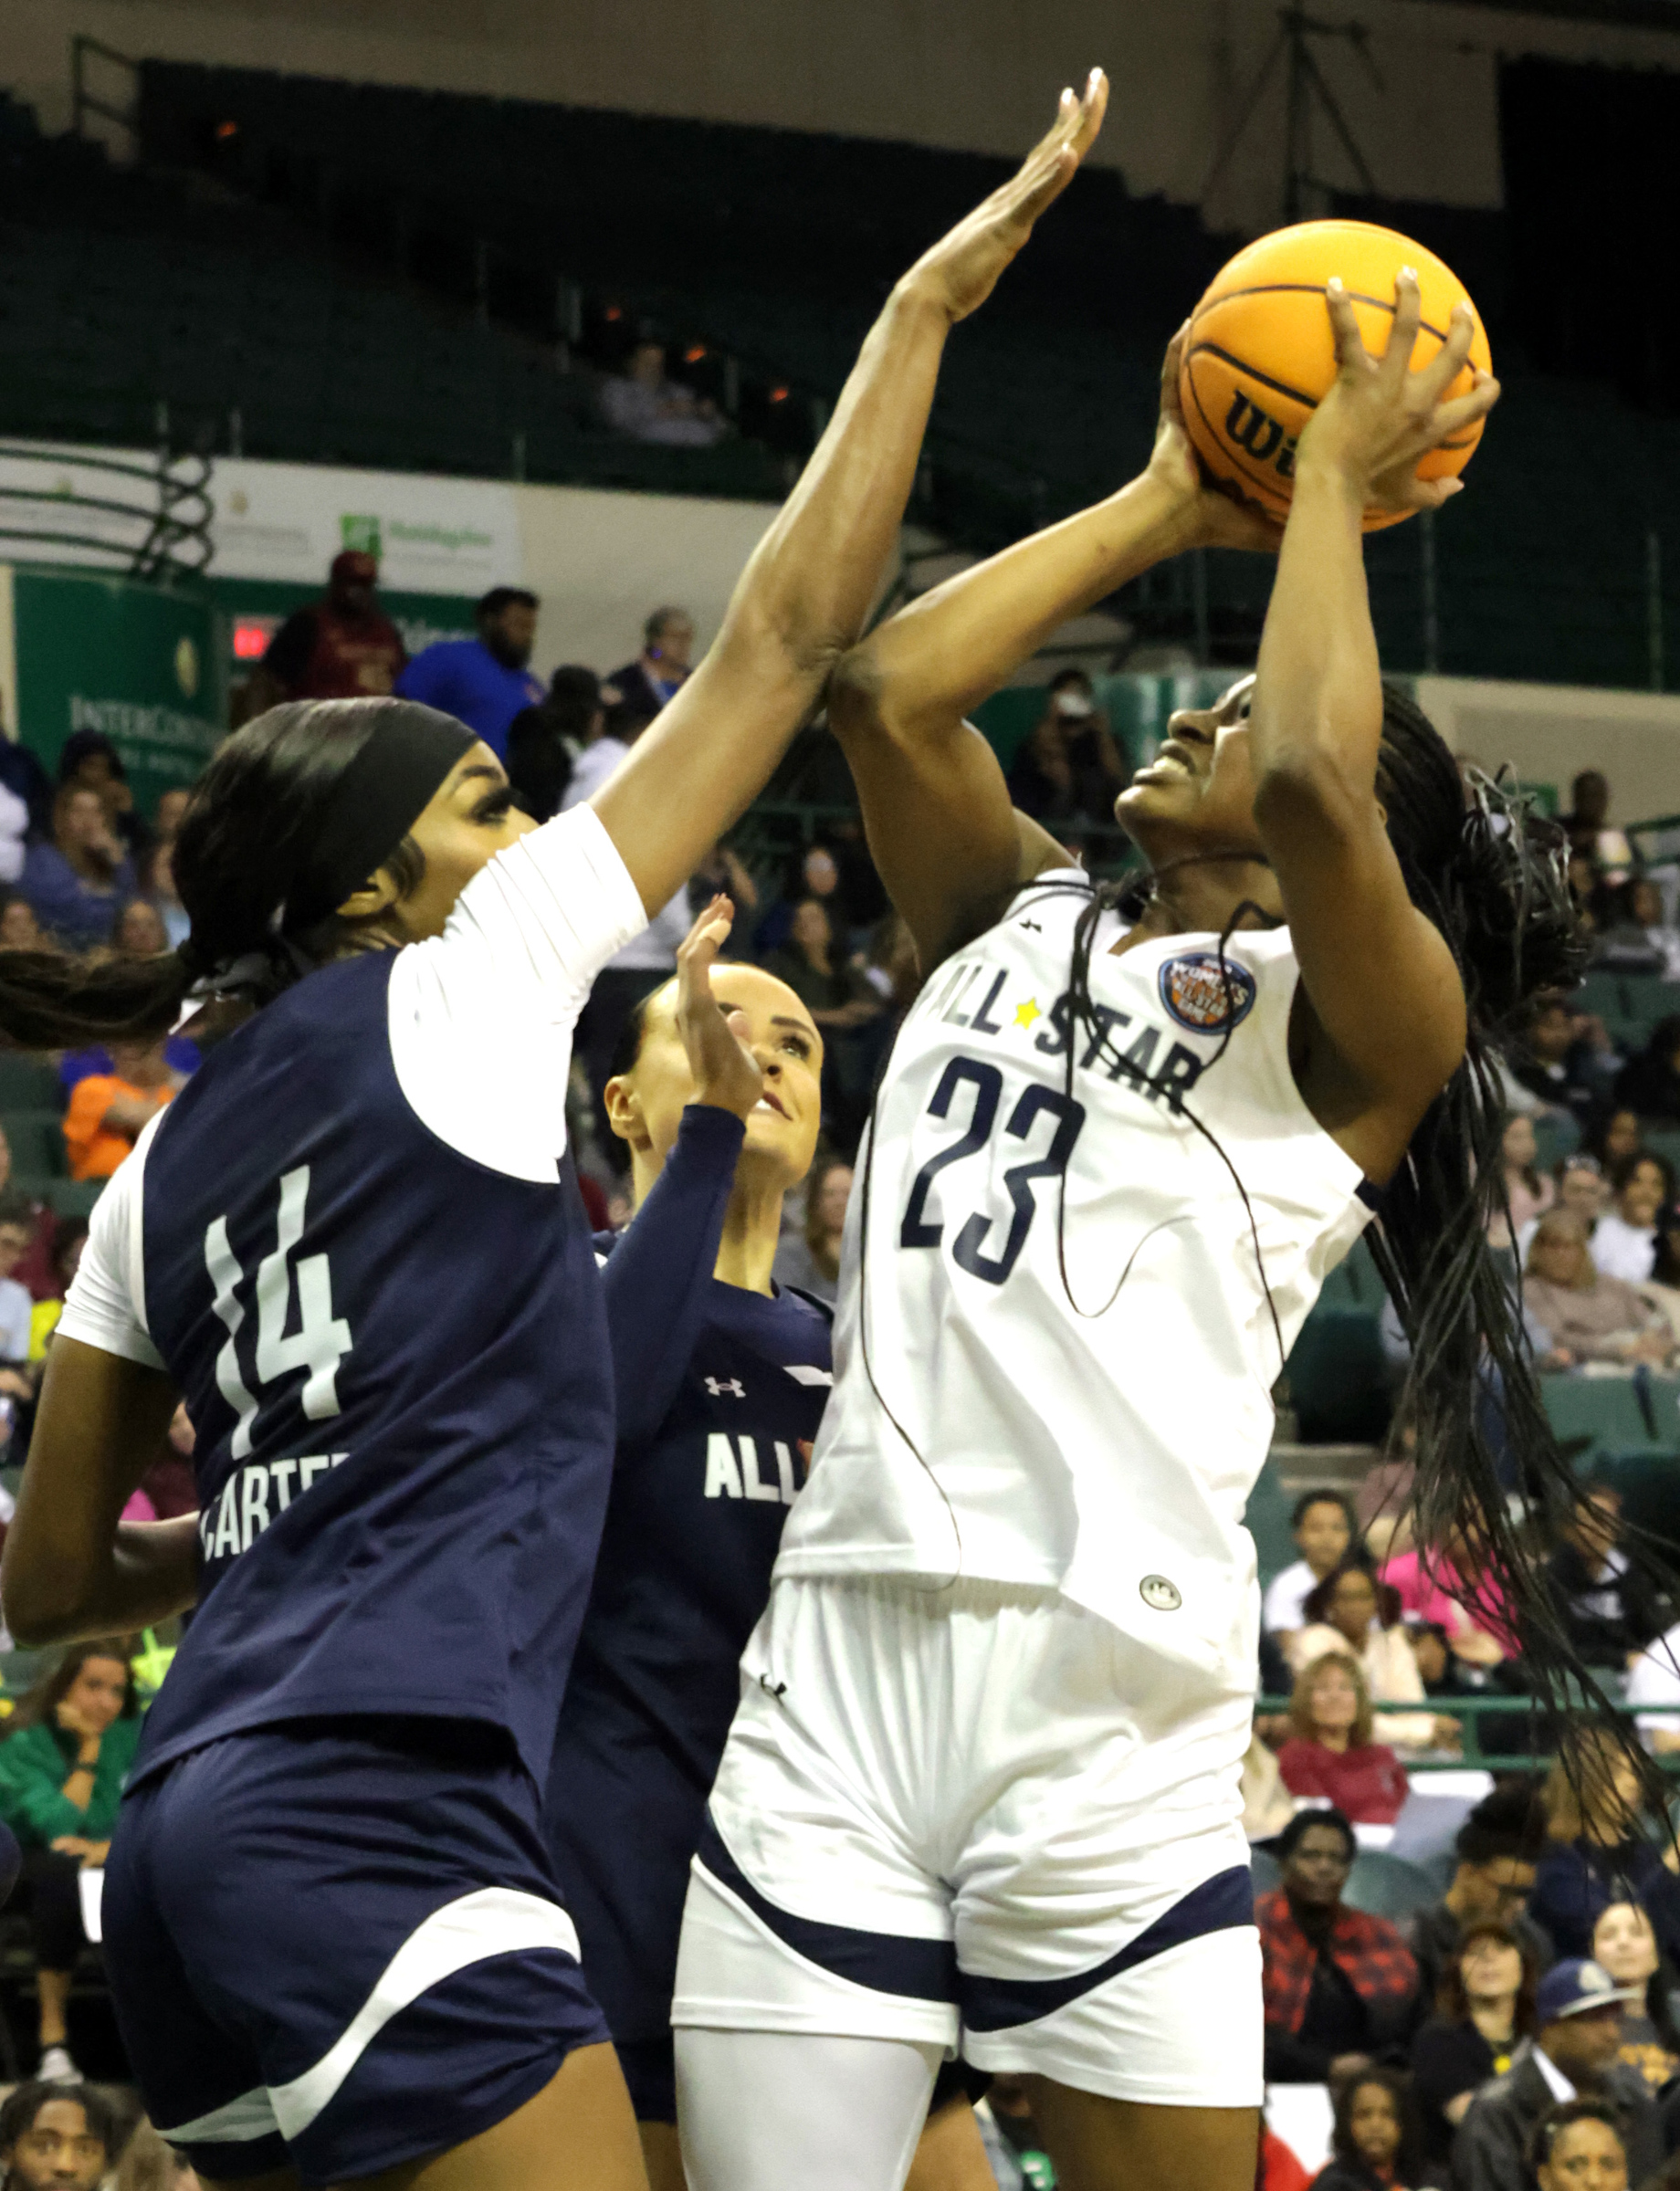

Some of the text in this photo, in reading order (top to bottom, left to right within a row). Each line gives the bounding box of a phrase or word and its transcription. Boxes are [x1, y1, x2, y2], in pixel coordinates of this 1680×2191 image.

[1034, 991, 1205, 1117] STAR
[901, 1055, 1087, 1286] 23
[204, 1164, 353, 1461] 14
[200, 1452, 351, 1562] CART
[704, 1432, 802, 1506] ALL
